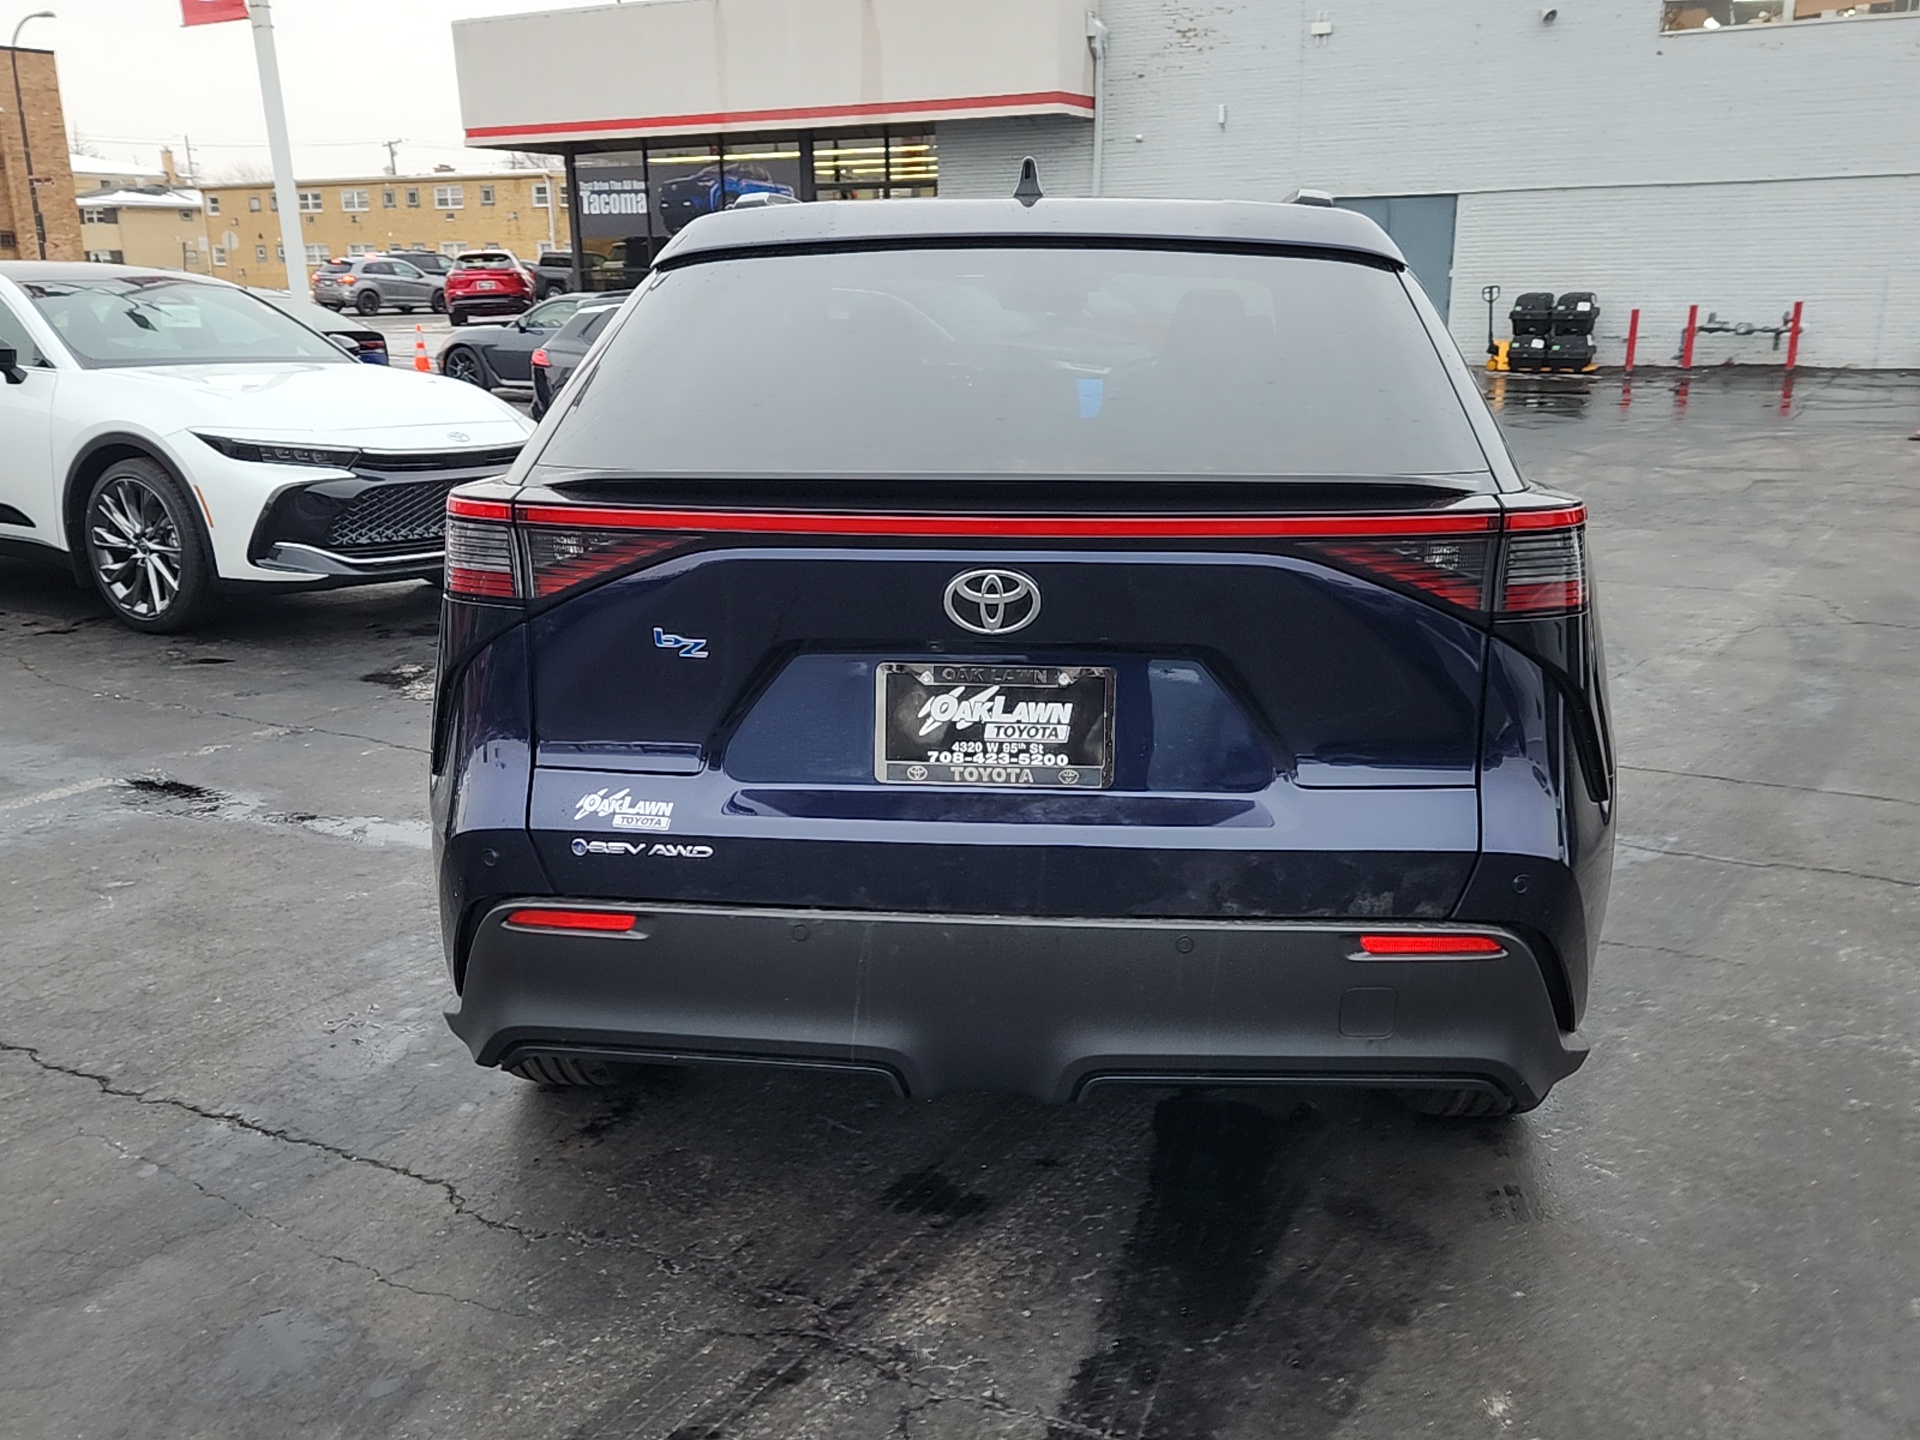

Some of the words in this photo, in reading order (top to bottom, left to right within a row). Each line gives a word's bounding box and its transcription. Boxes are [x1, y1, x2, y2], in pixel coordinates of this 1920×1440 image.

[579, 191, 647, 214] Tacoma
[994, 725, 1060, 739] TOYOTA
[951, 741, 983, 753] 4320
[986, 742, 999, 753] W
[1029, 743, 1045, 755] St
[927, 751, 1069, 767] 708-423-5200
[950, 766, 1034, 783] TOYOTA
[620, 815, 663, 827] TOYOTA
[647, 843, 714, 858] AWD
